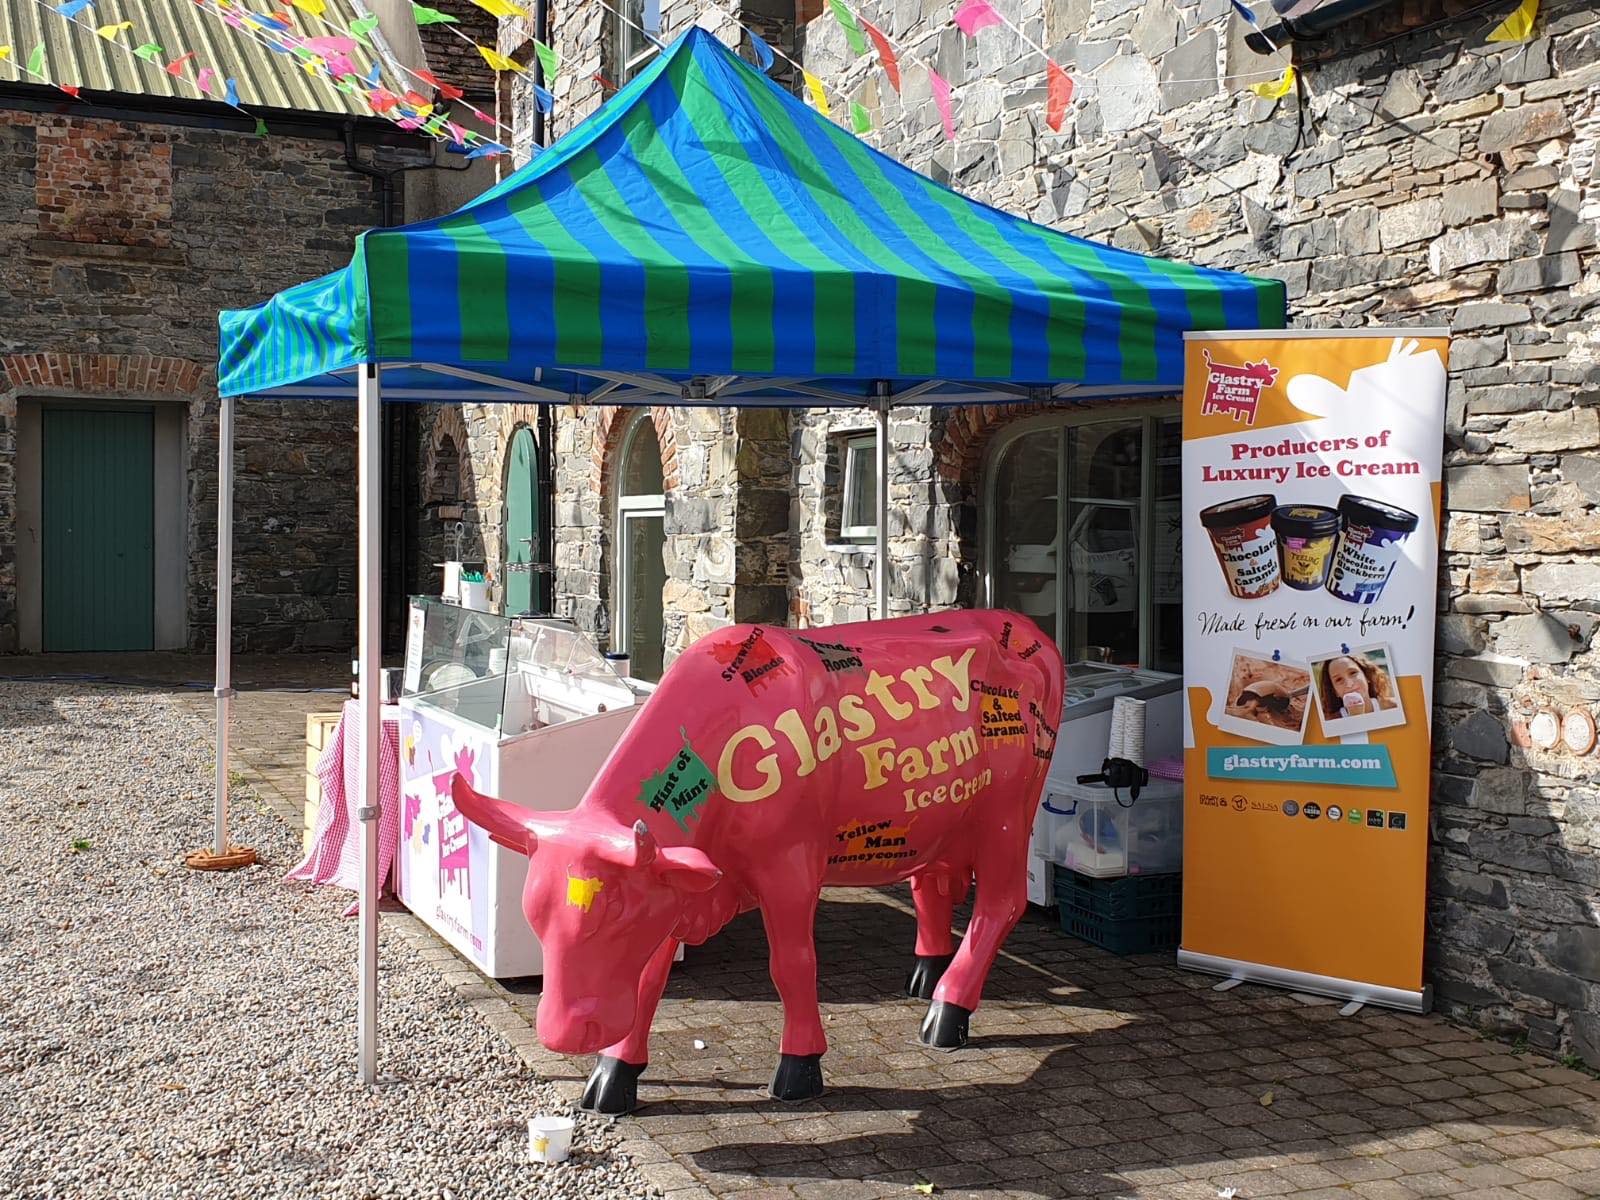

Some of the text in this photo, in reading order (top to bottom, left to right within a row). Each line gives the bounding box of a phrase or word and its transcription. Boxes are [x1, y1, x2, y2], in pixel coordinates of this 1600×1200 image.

[1209, 372, 1264, 388] Glastry
[1217, 384, 1250, 395] Farm
[1226, 394, 1254, 402] Cream
[1231, 430, 1391, 460] Producers of
[1202, 460, 1420, 483] Luxury Ice Cream
[1336, 551, 1378, 571] Chocolate
[1343, 544, 1376, 564] White
[1234, 561, 1278, 585] Caramel
[1237, 559, 1273, 576] Salted
[1337, 559, 1386, 579] Blackberry
[1198, 605, 1415, 640] Made fresh on our farm!
[721, 626, 764, 682] Strawberry
[741, 655, 785, 684] Blonde
[821, 656, 863, 673] Honey
[992, 698, 1002, 710] &
[717, 647, 976, 803] Glastry
[983, 710, 1022, 723] Salted
[980, 723, 1029, 737] Caramel
[856, 724, 981, 790] Farm
[1223, 754, 1382, 772] glastryfarm.com
[650, 750, 691, 813] Hint of
[671, 778, 708, 811] Mint
[903, 785, 947, 812] Ice
[836, 820, 892, 843] Yellow
[864, 836, 906, 848] Man
[827, 849, 917, 865] Honeycomb
